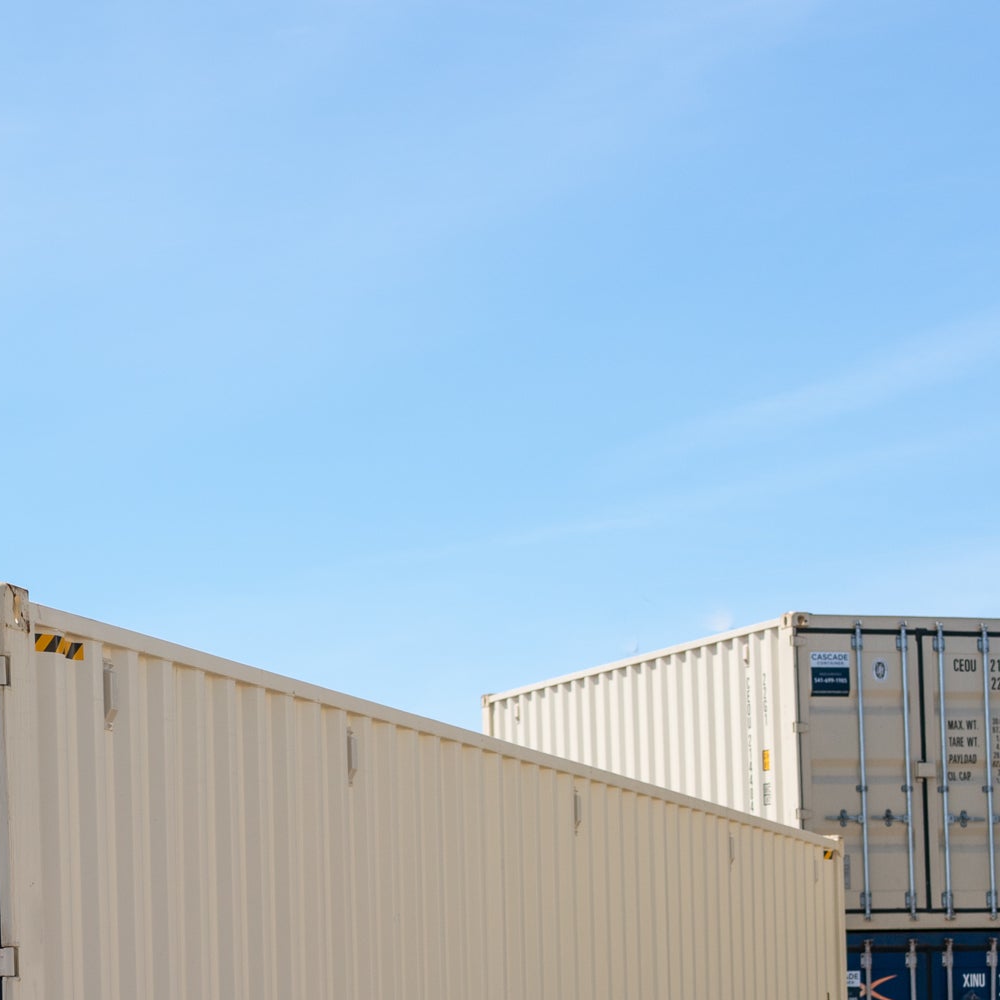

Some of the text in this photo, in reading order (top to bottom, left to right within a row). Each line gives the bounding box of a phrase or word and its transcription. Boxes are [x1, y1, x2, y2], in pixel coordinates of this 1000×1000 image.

[811, 653, 848, 661] CASCADE
[948, 737, 964, 747] TARE
[962, 973, 985, 988] XINU
